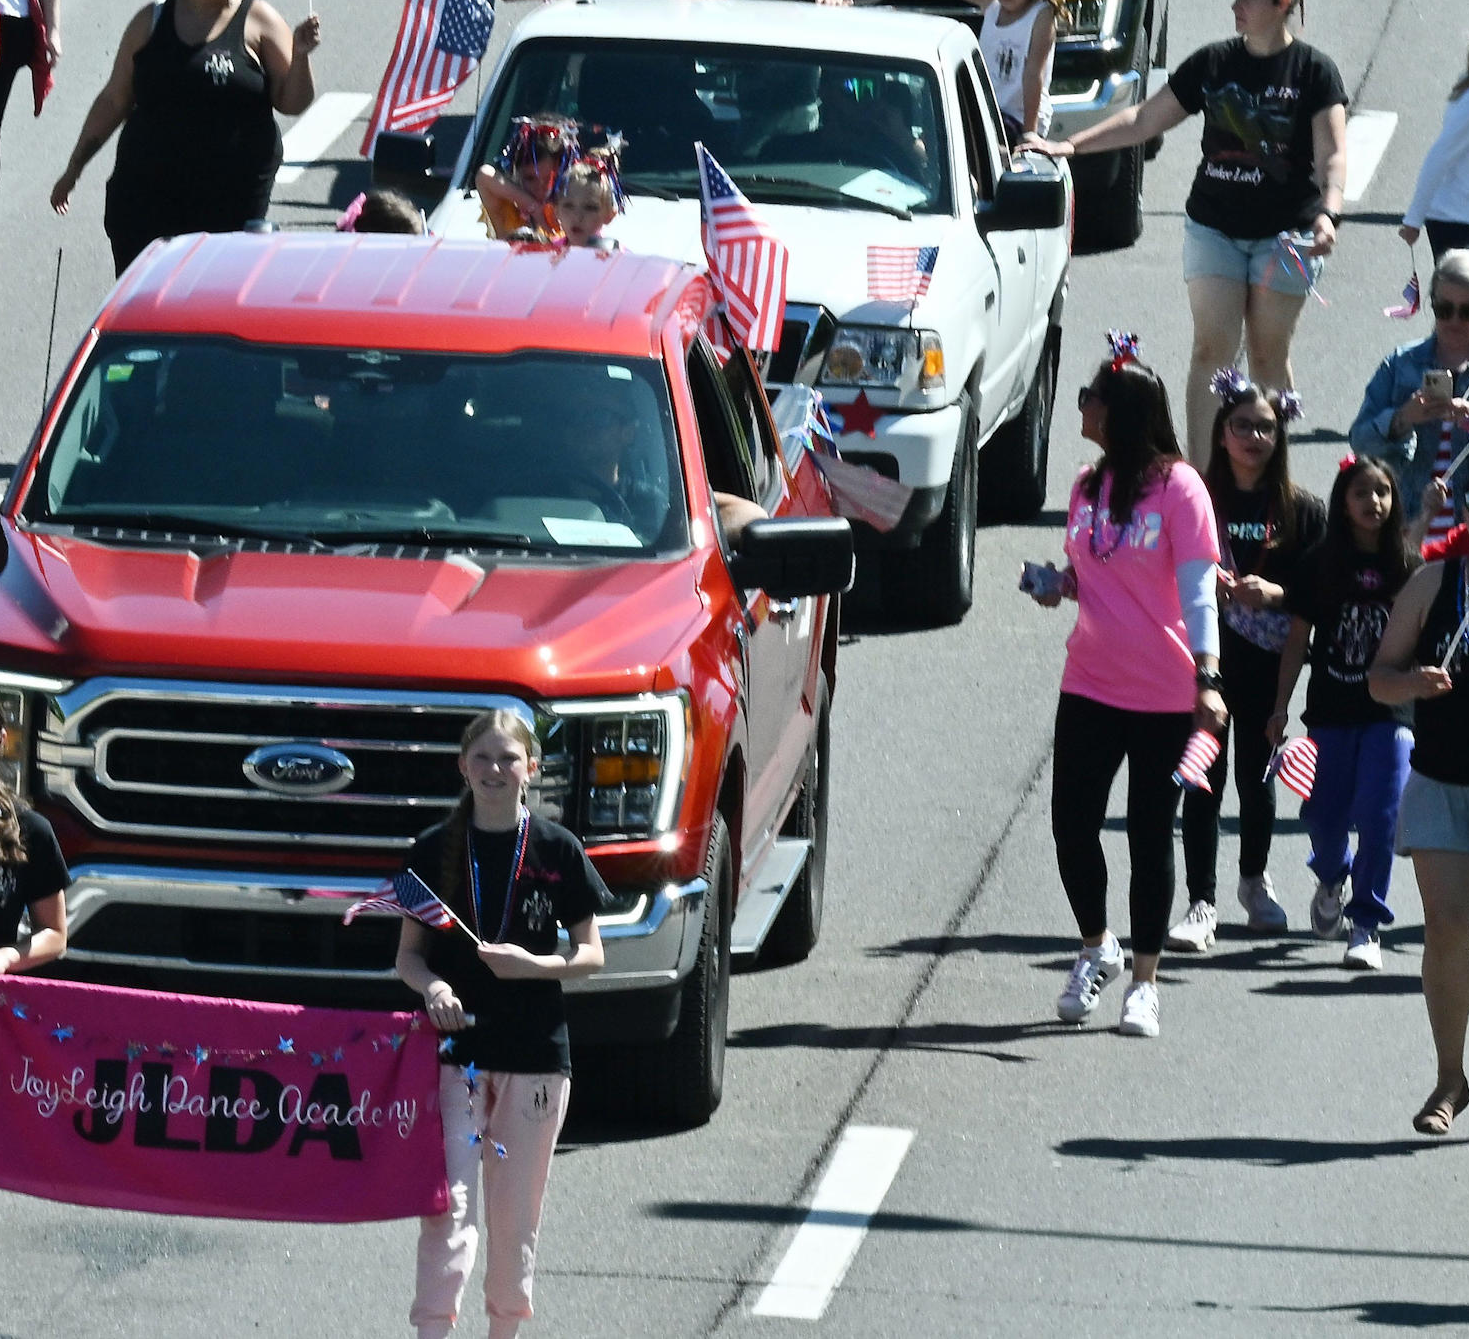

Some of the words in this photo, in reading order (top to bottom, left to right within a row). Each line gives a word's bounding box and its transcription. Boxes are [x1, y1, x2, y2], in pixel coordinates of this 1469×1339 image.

[272, 757, 325, 780] Ford
[73, 1058, 363, 1161] JLDA
[163, 1073, 270, 1121] Dance
